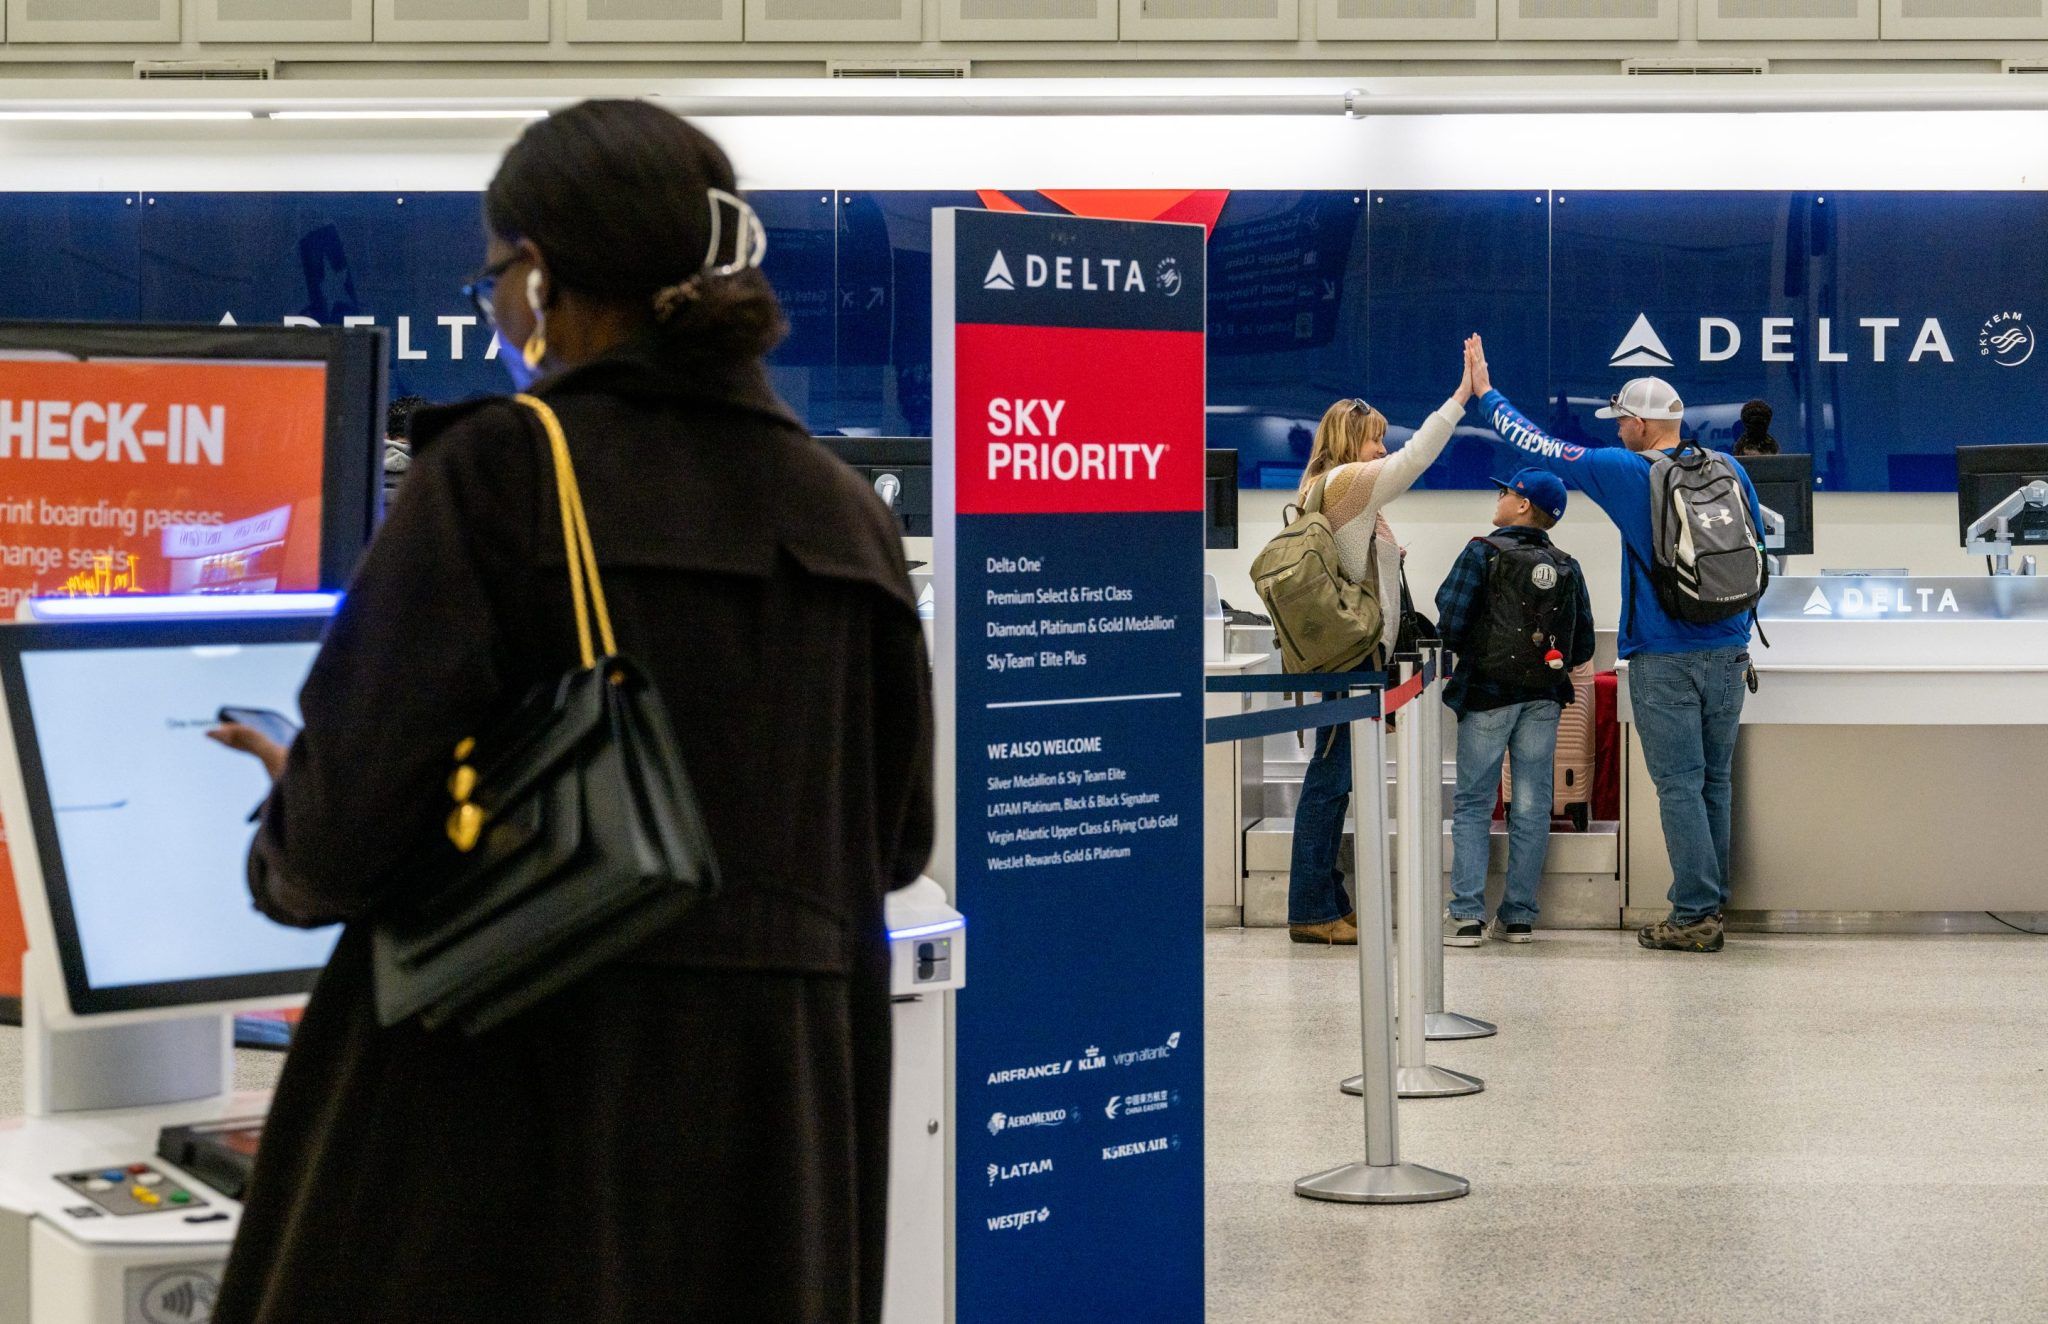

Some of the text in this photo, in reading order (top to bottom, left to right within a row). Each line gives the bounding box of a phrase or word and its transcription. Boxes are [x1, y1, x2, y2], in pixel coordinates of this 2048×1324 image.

[1026, 254, 1145, 292] DELTA
[1699, 317, 1955, 362] DELTA
[987, 397, 1066, 437] SKY
[1492, 408, 1565, 459] MAGELLAN
[987, 442, 1165, 481] PRIORITY
[40, 498, 138, 536] boarding
[143, 504, 223, 536] passes
[68, 546, 129, 572] seats
[987, 556, 1041, 573] Delta One
[987, 586, 1133, 605] Premium Select & First Class
[1842, 588, 1960, 613] DELTA
[987, 616, 1175, 638] Diamond, Platinum & Gold Medallion
[987, 650, 1087, 672] SkyTeam Elite Plus
[988, 737, 1102, 760] WE ALSO WELCOME
[988, 768, 1127, 790] Silver Medallion & Sky Team Elite
[988, 792, 1160, 817] LATAM Platinum, Black & Black Signature
[988, 815, 1178, 846] Virgin Atlantic Upper Class & Flying Club Gold
[988, 847, 1131, 871] WestJet Rewards Gold & Platinum
[987, 1063, 1061, 1085] AIRFRANCE
[1079, 1056, 1106, 1071] KLM
[1125, 1102, 1168, 1116] CHINA EASTERN
[1102, 1137, 1168, 1160] KOREAN AIR
[1001, 1158, 1054, 1180] LATAM
[987, 1209, 1038, 1231] WESTJET
